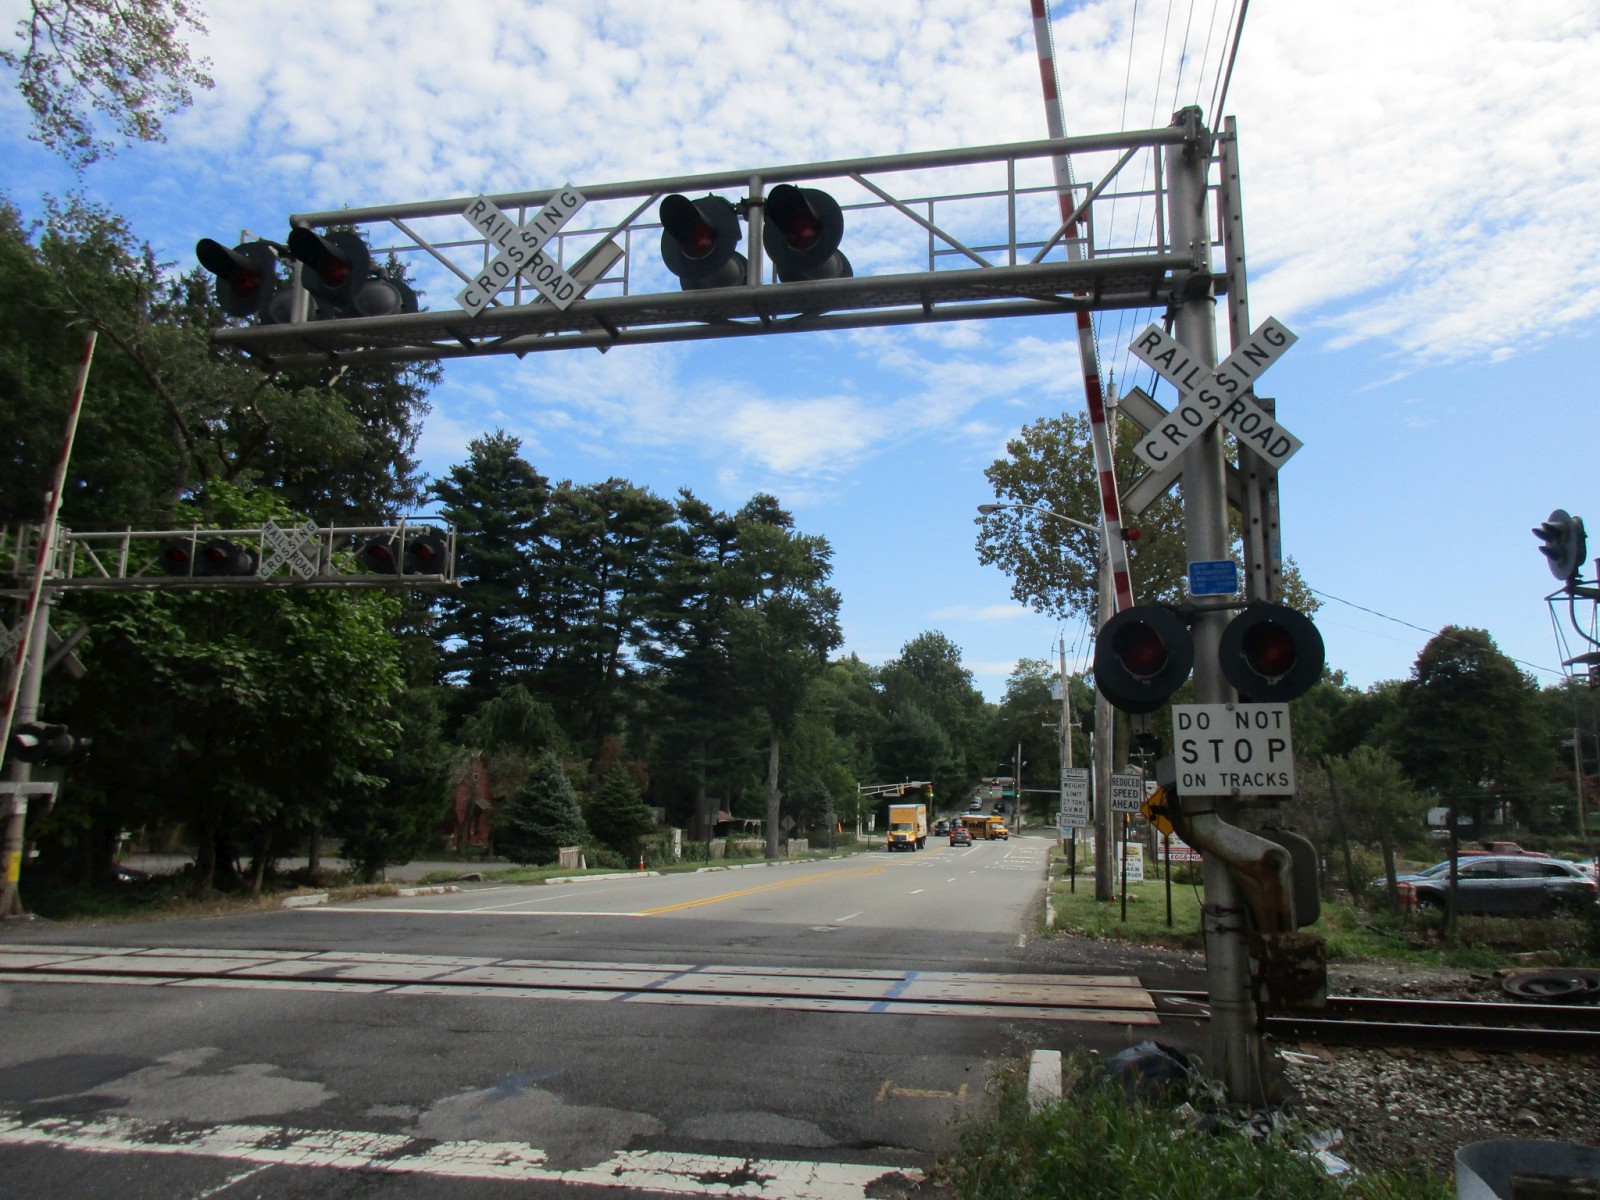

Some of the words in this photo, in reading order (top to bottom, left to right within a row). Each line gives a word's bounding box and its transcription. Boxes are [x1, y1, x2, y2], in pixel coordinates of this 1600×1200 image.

[464, 191, 577, 308] CROSSING
[468, 199, 512, 248] RAIL
[527, 252, 574, 301] ROAD
[1138, 330, 1200, 391] RAIL
[1225, 398, 1291, 458] ROAD
[1145, 326, 1286, 462] CROSSING
[260, 522, 316, 577] CROSSING
[263, 523, 284, 548] RAIL
[290, 552, 313, 577] ROAD
[1178, 711, 1211, 730] DO
[1235, 710, 1284, 729] NOT
[1181, 737, 1286, 764] STOP
[1111, 777, 1140, 787] REDUCED
[1113, 788, 1139, 799] SPEED
[1182, 773, 1206, 788] ON
[1219, 771, 1290, 787] TRACKS
[1112, 799, 1139, 810] AHEAD
